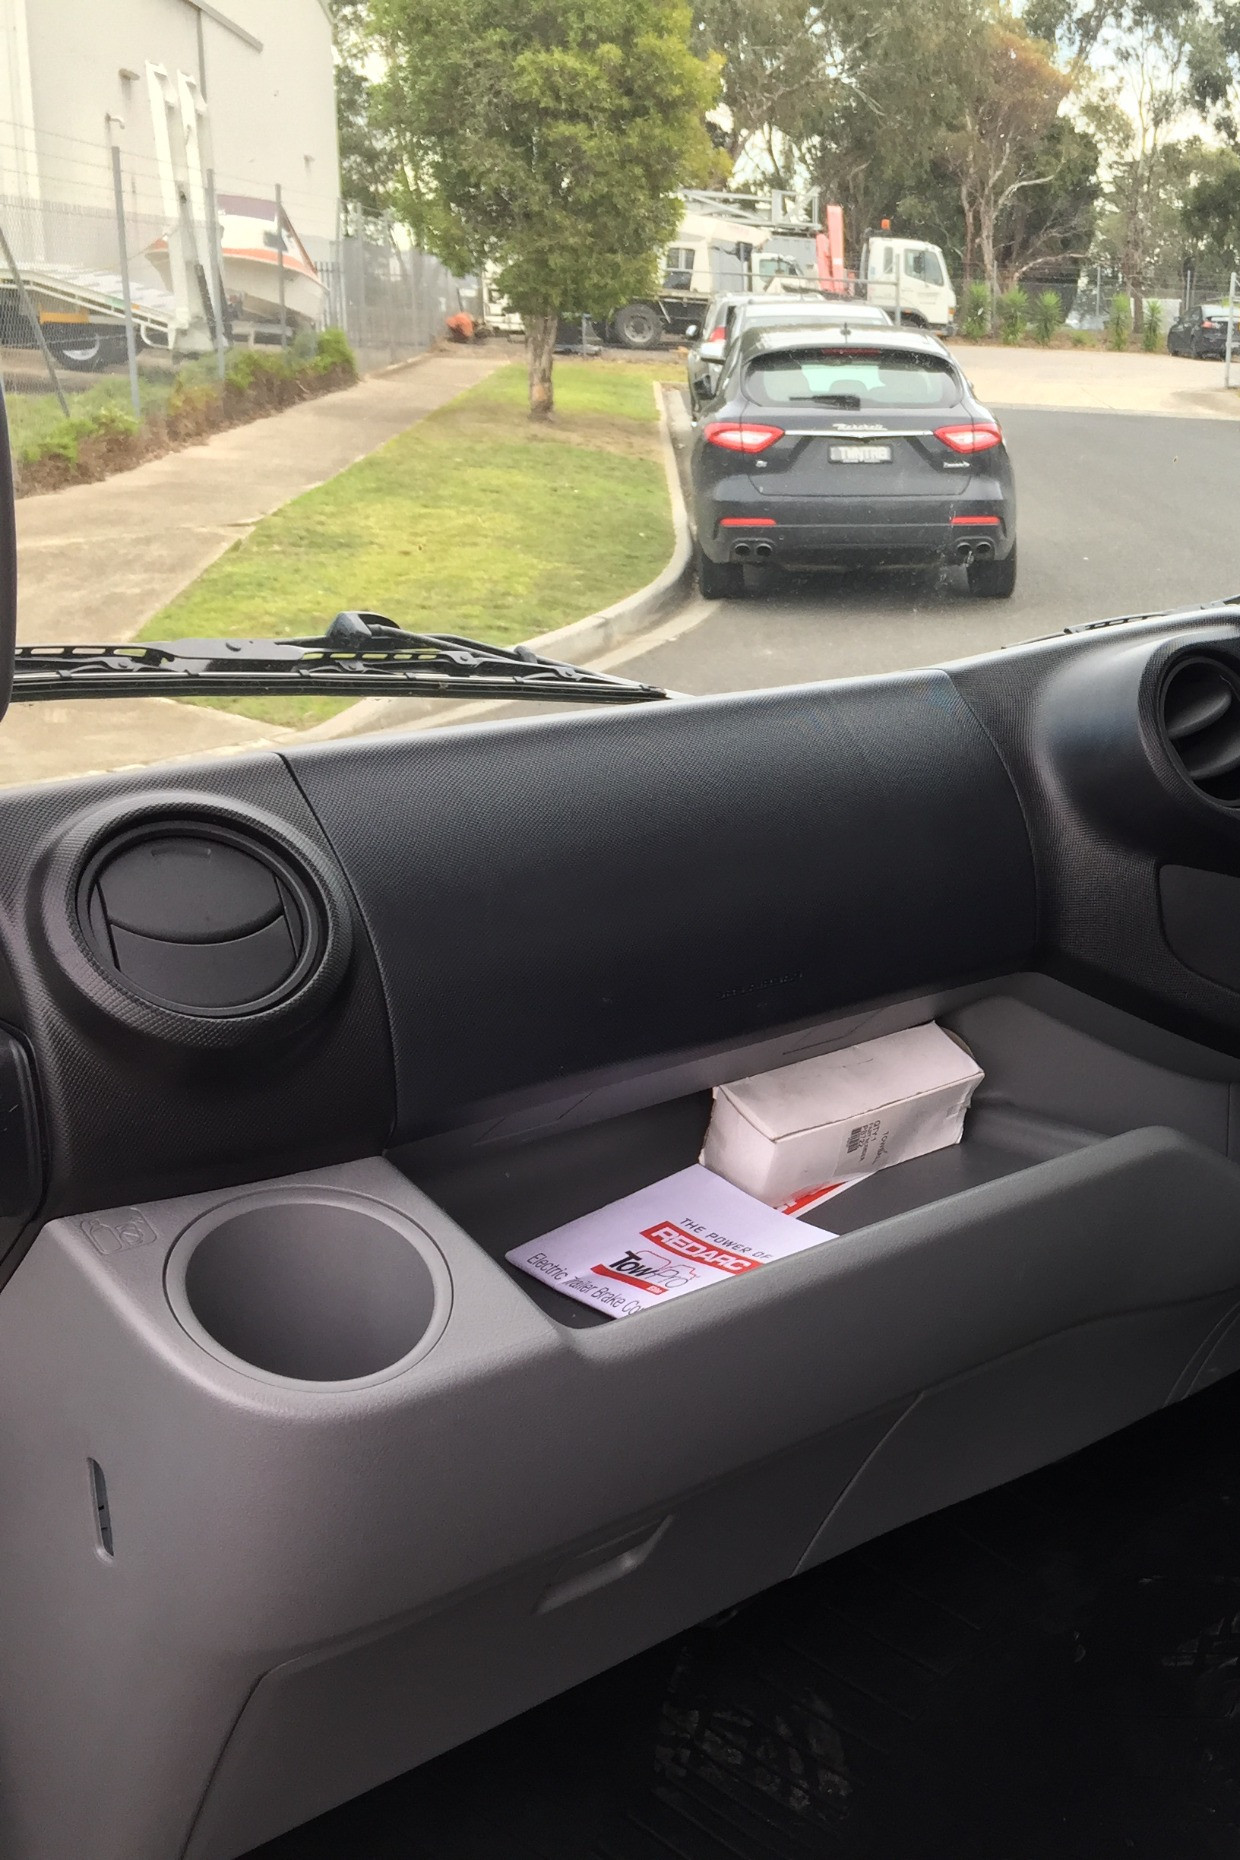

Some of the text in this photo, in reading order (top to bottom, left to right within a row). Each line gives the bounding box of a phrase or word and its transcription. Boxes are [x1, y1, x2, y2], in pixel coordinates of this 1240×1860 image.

[651, 1226, 752, 1271] REDARC
[680, 1217, 773, 1259] THE POWER OF
[526, 1252, 569, 1281] Electric
[562, 1275, 598, 1294] Trailer
[590, 1286, 626, 1308] Brake
